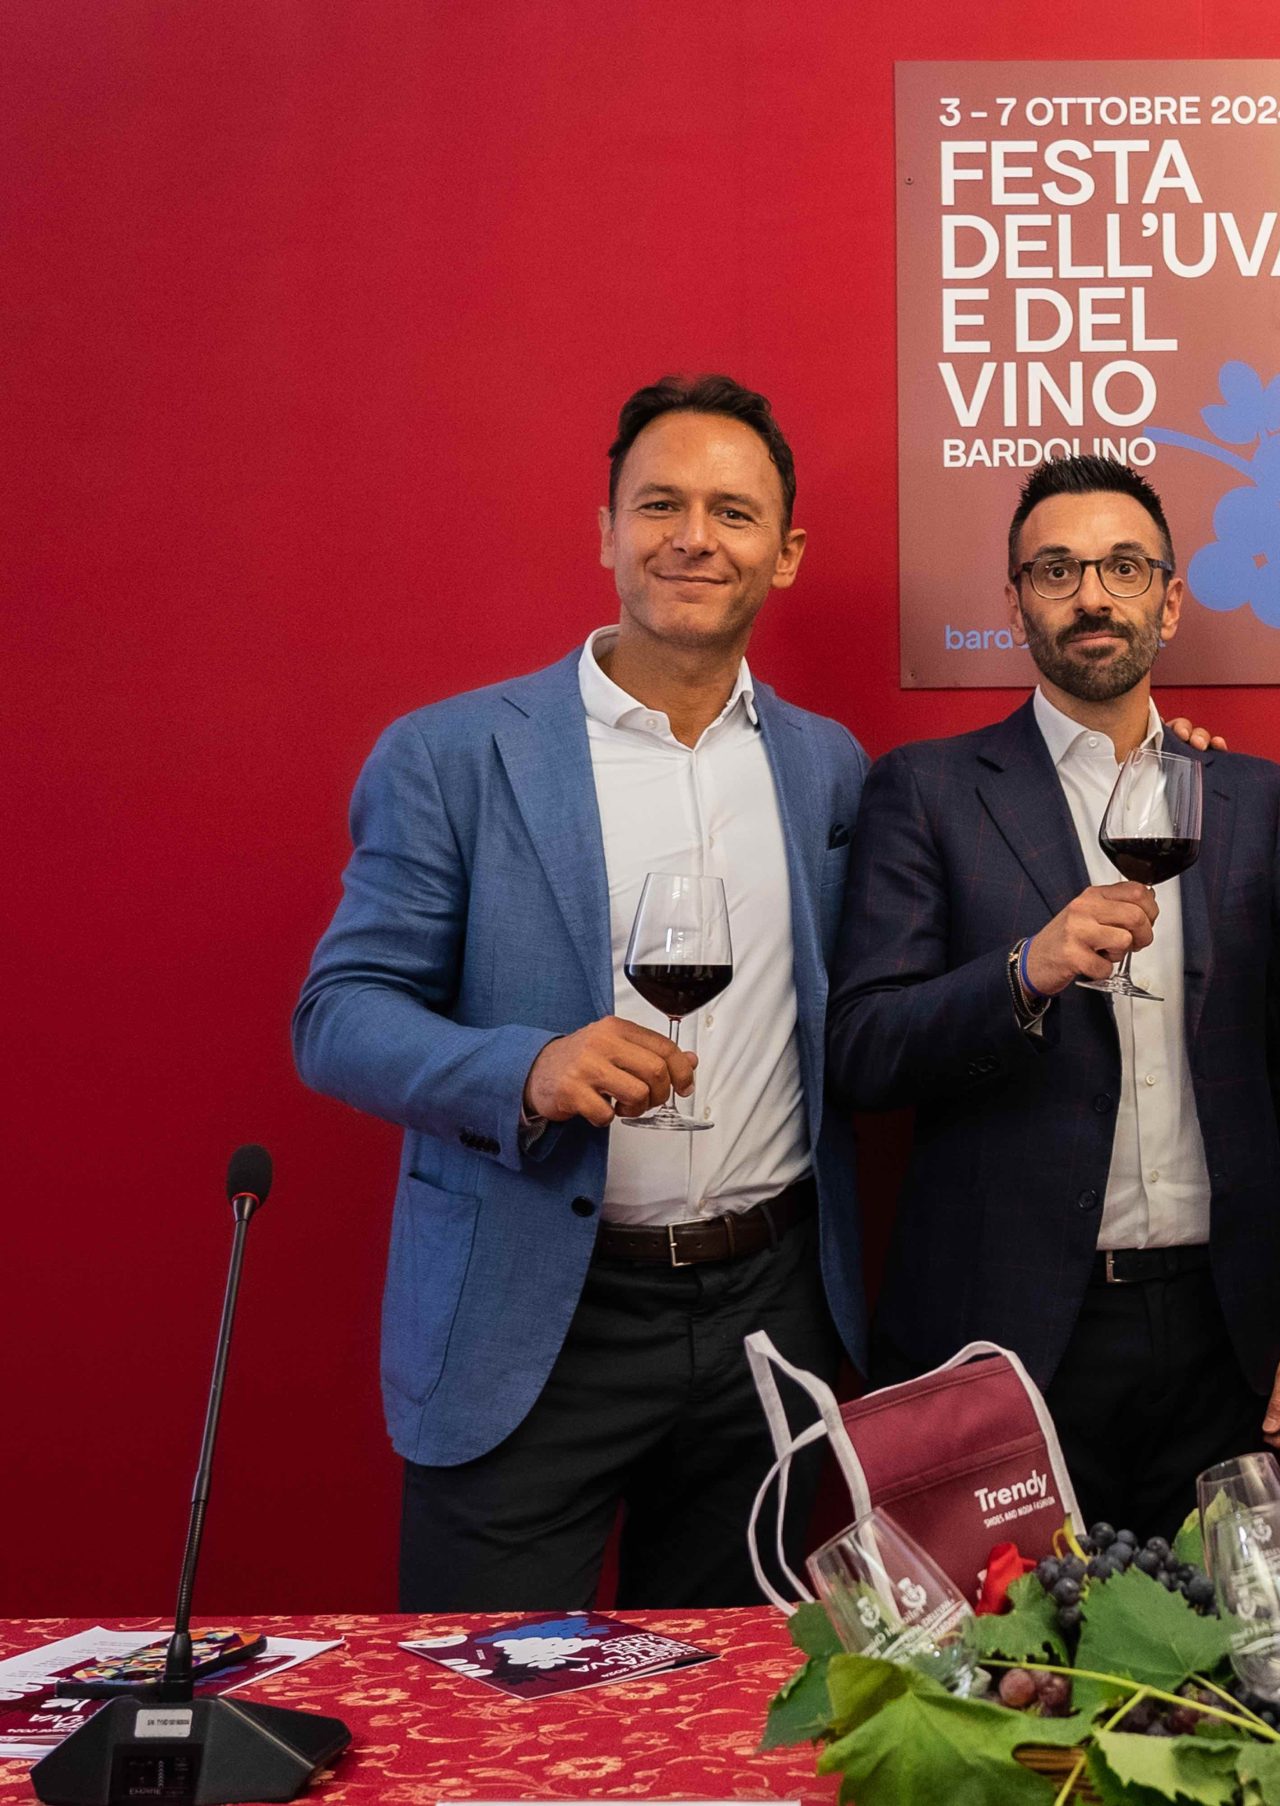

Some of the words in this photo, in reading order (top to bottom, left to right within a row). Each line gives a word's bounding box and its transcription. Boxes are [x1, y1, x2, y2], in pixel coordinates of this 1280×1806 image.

[939, 97, 961, 127] 3
[995, 97, 1017, 126] 7
[1025, 95, 1202, 127] OTTOBRE
[940, 139, 1203, 206] FESTA
[942, 288, 991, 354] E
[1015, 286, 1178, 353] DEL
[937, 359, 1157, 427] VINO
[974, 1469, 1047, 1512] Trendy
